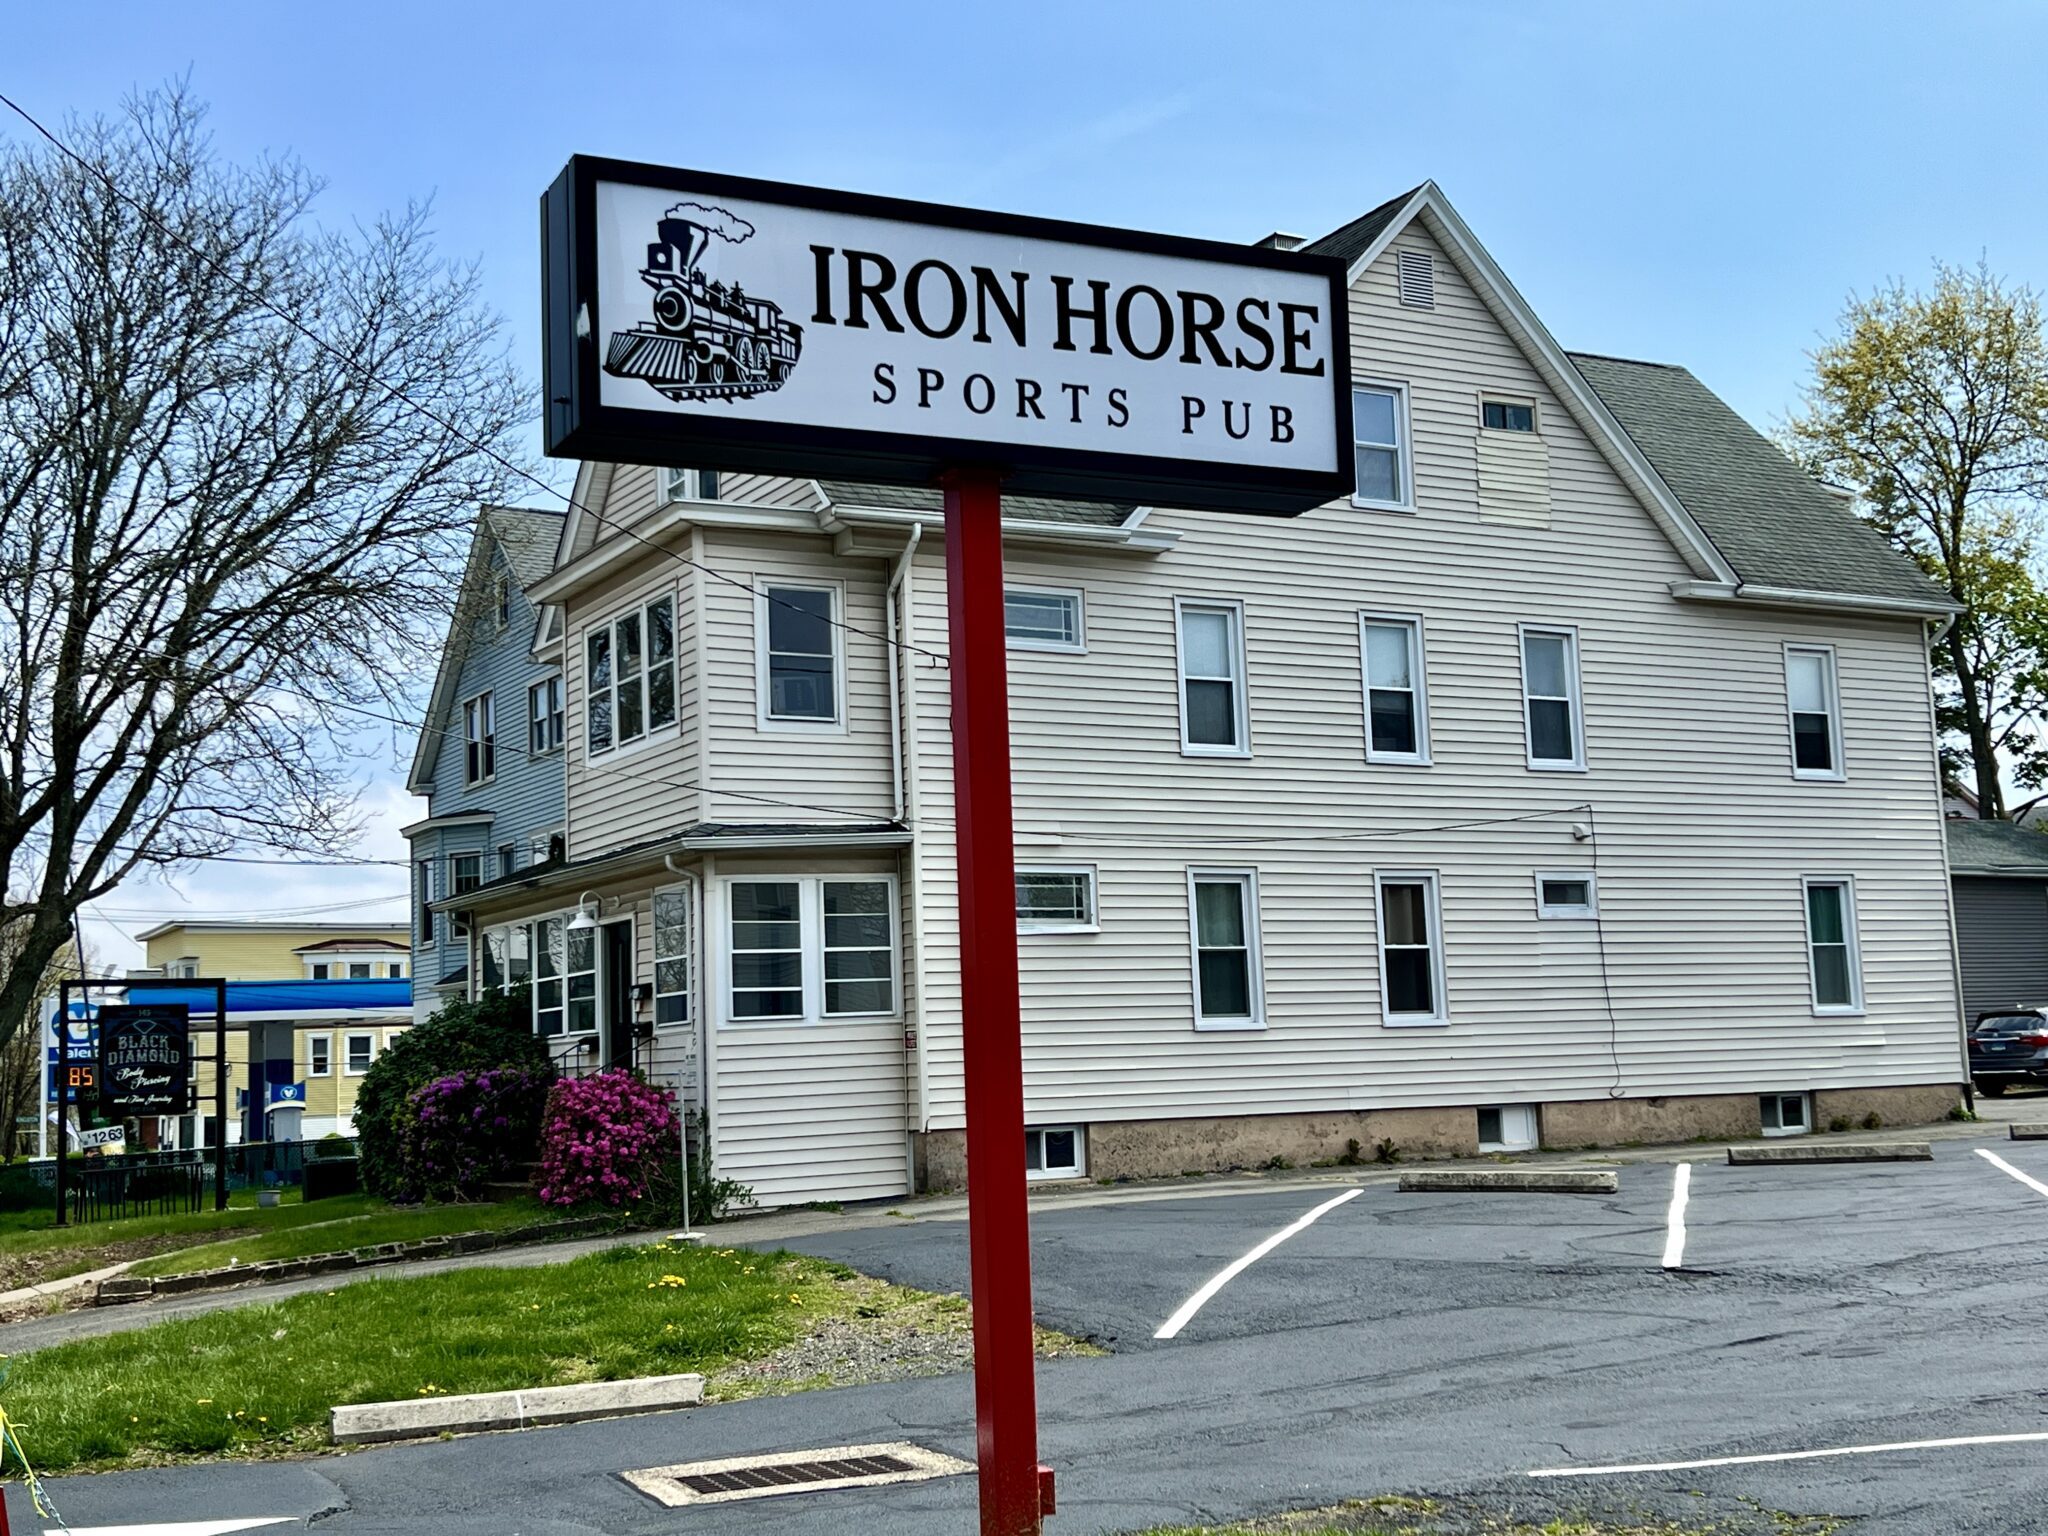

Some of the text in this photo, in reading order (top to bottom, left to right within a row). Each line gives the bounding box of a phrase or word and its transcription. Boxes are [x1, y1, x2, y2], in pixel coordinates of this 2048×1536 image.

[810, 245, 1325, 378] IRON HORSE
[873, 364, 1295, 444] SPORTS PUB
[118, 1035, 169, 1050] BLACK
[108, 1049, 180, 1066] DIAMOND
[116, 1066, 145, 1081] Body
[130, 1075, 171, 1090] Piercing
